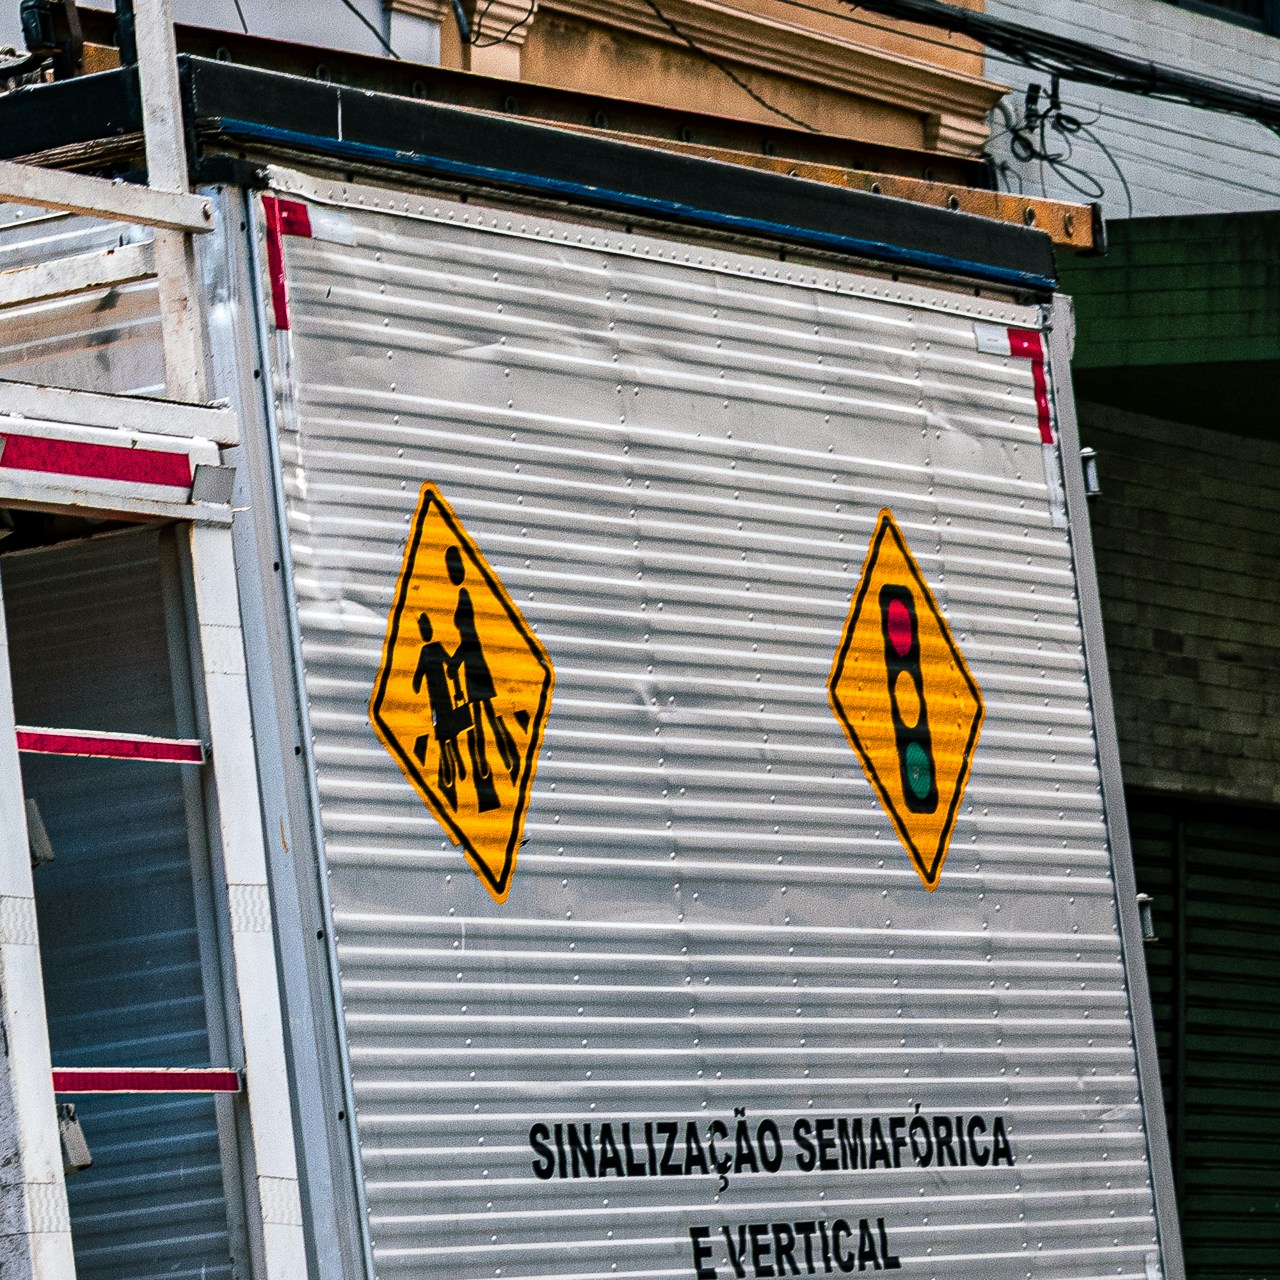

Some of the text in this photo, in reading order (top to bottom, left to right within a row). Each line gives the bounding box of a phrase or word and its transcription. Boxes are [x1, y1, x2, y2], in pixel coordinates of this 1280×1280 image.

[529, 1102, 1015, 1193] SINALIZAÇÃO SEMAFÓRICA
[689, 1217, 902, 1280] E VERTICAL
